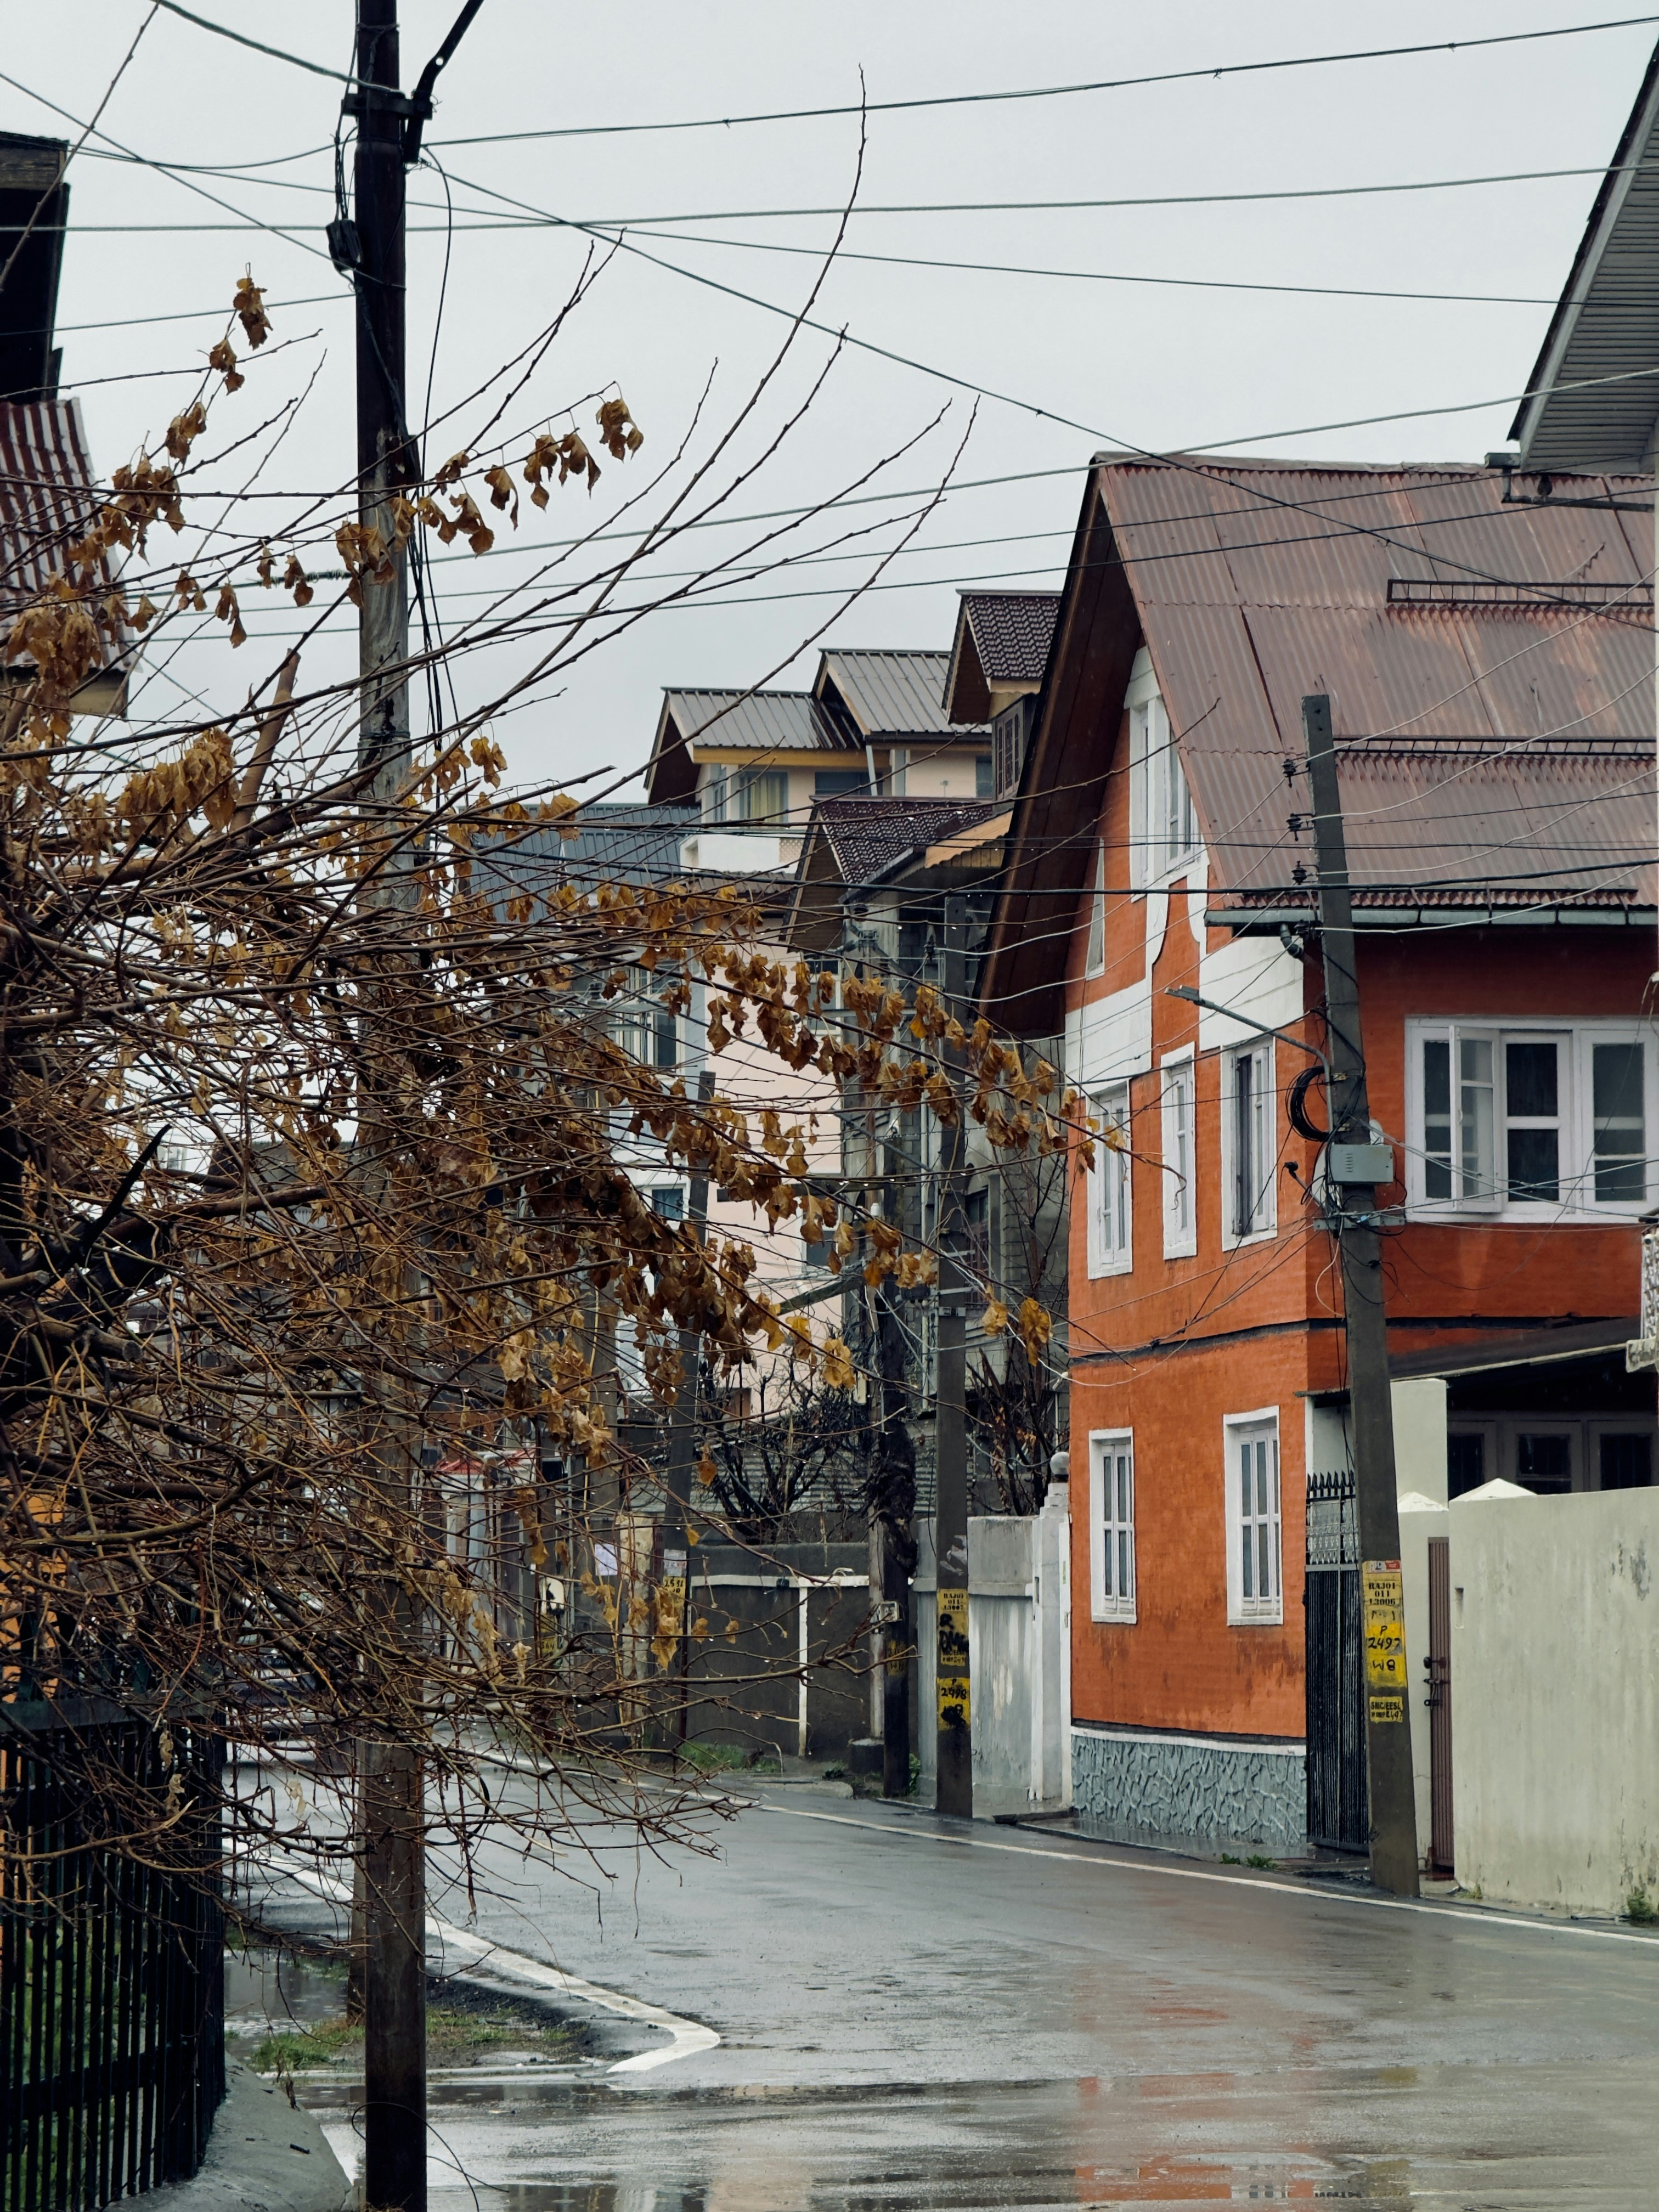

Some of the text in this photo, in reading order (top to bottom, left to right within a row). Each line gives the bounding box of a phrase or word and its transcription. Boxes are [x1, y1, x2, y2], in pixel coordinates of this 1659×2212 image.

[1380, 1626, 1387, 1635] P
[1368, 1637, 1400, 1649] 2497
[941, 1687, 967, 1700] 2498
